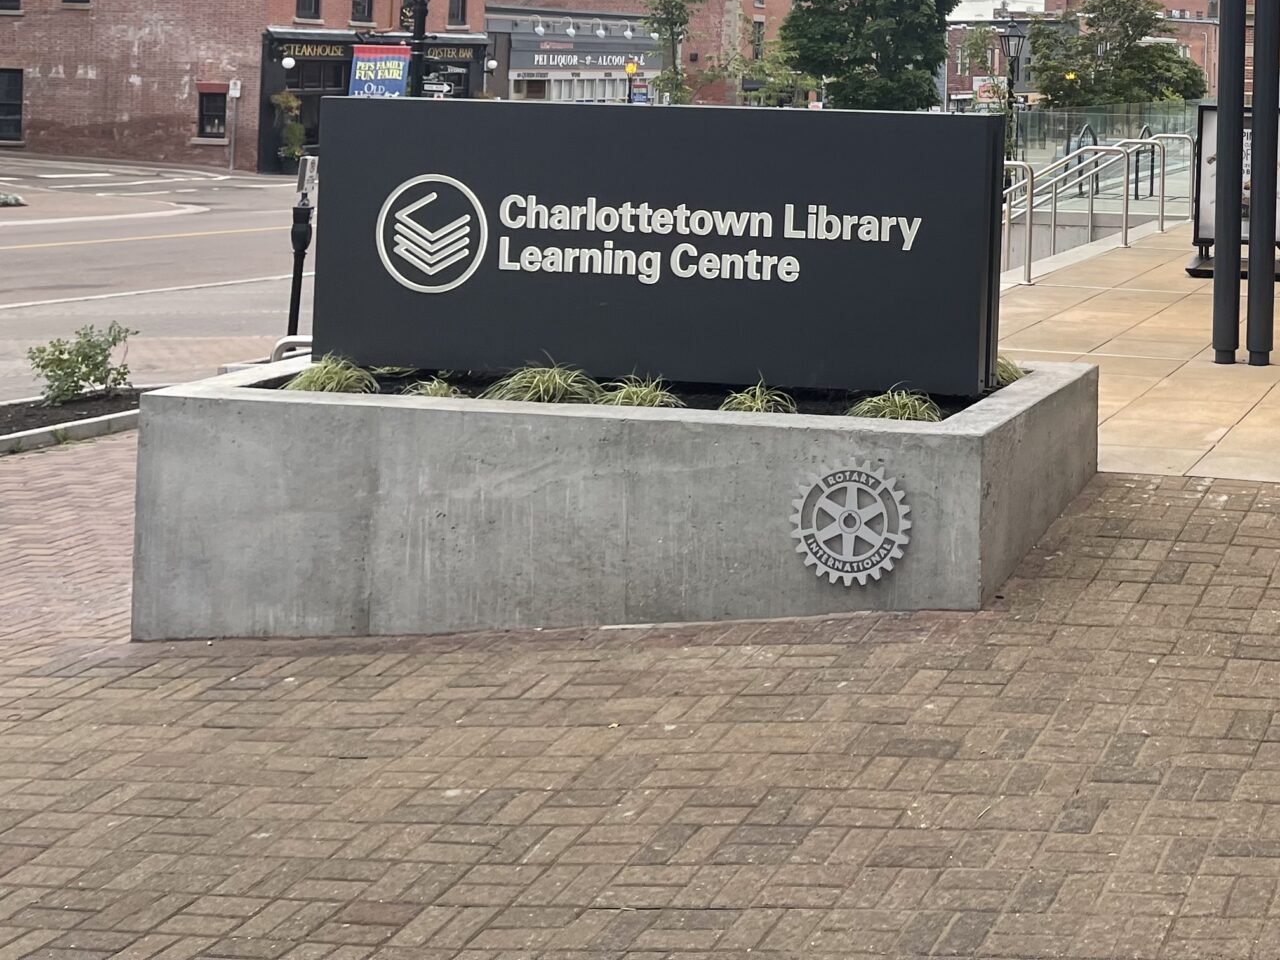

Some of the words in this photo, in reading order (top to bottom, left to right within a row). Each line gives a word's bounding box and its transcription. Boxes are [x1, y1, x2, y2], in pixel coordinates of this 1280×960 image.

[283, 44, 344, 57] STEAKHOUSE
[427, 47, 457, 58] OYSTER
[458, 48, 474, 59] BAR
[376, 60, 405, 70] FAMILY
[534, 54, 547, 66] PEI
[550, 54, 578, 67] LIQUOR
[355, 70, 376, 80] FUN
[376, 69, 404, 80] FAIR!
[499, 194, 773, 238] Charlottetown
[782, 202, 923, 252] Library
[497, 236, 662, 284] Learning
[669, 242, 801, 283] Centre
[827, 471, 876, 486] ROTARY
[807, 538, 892, 572] INTERNATIONAL
